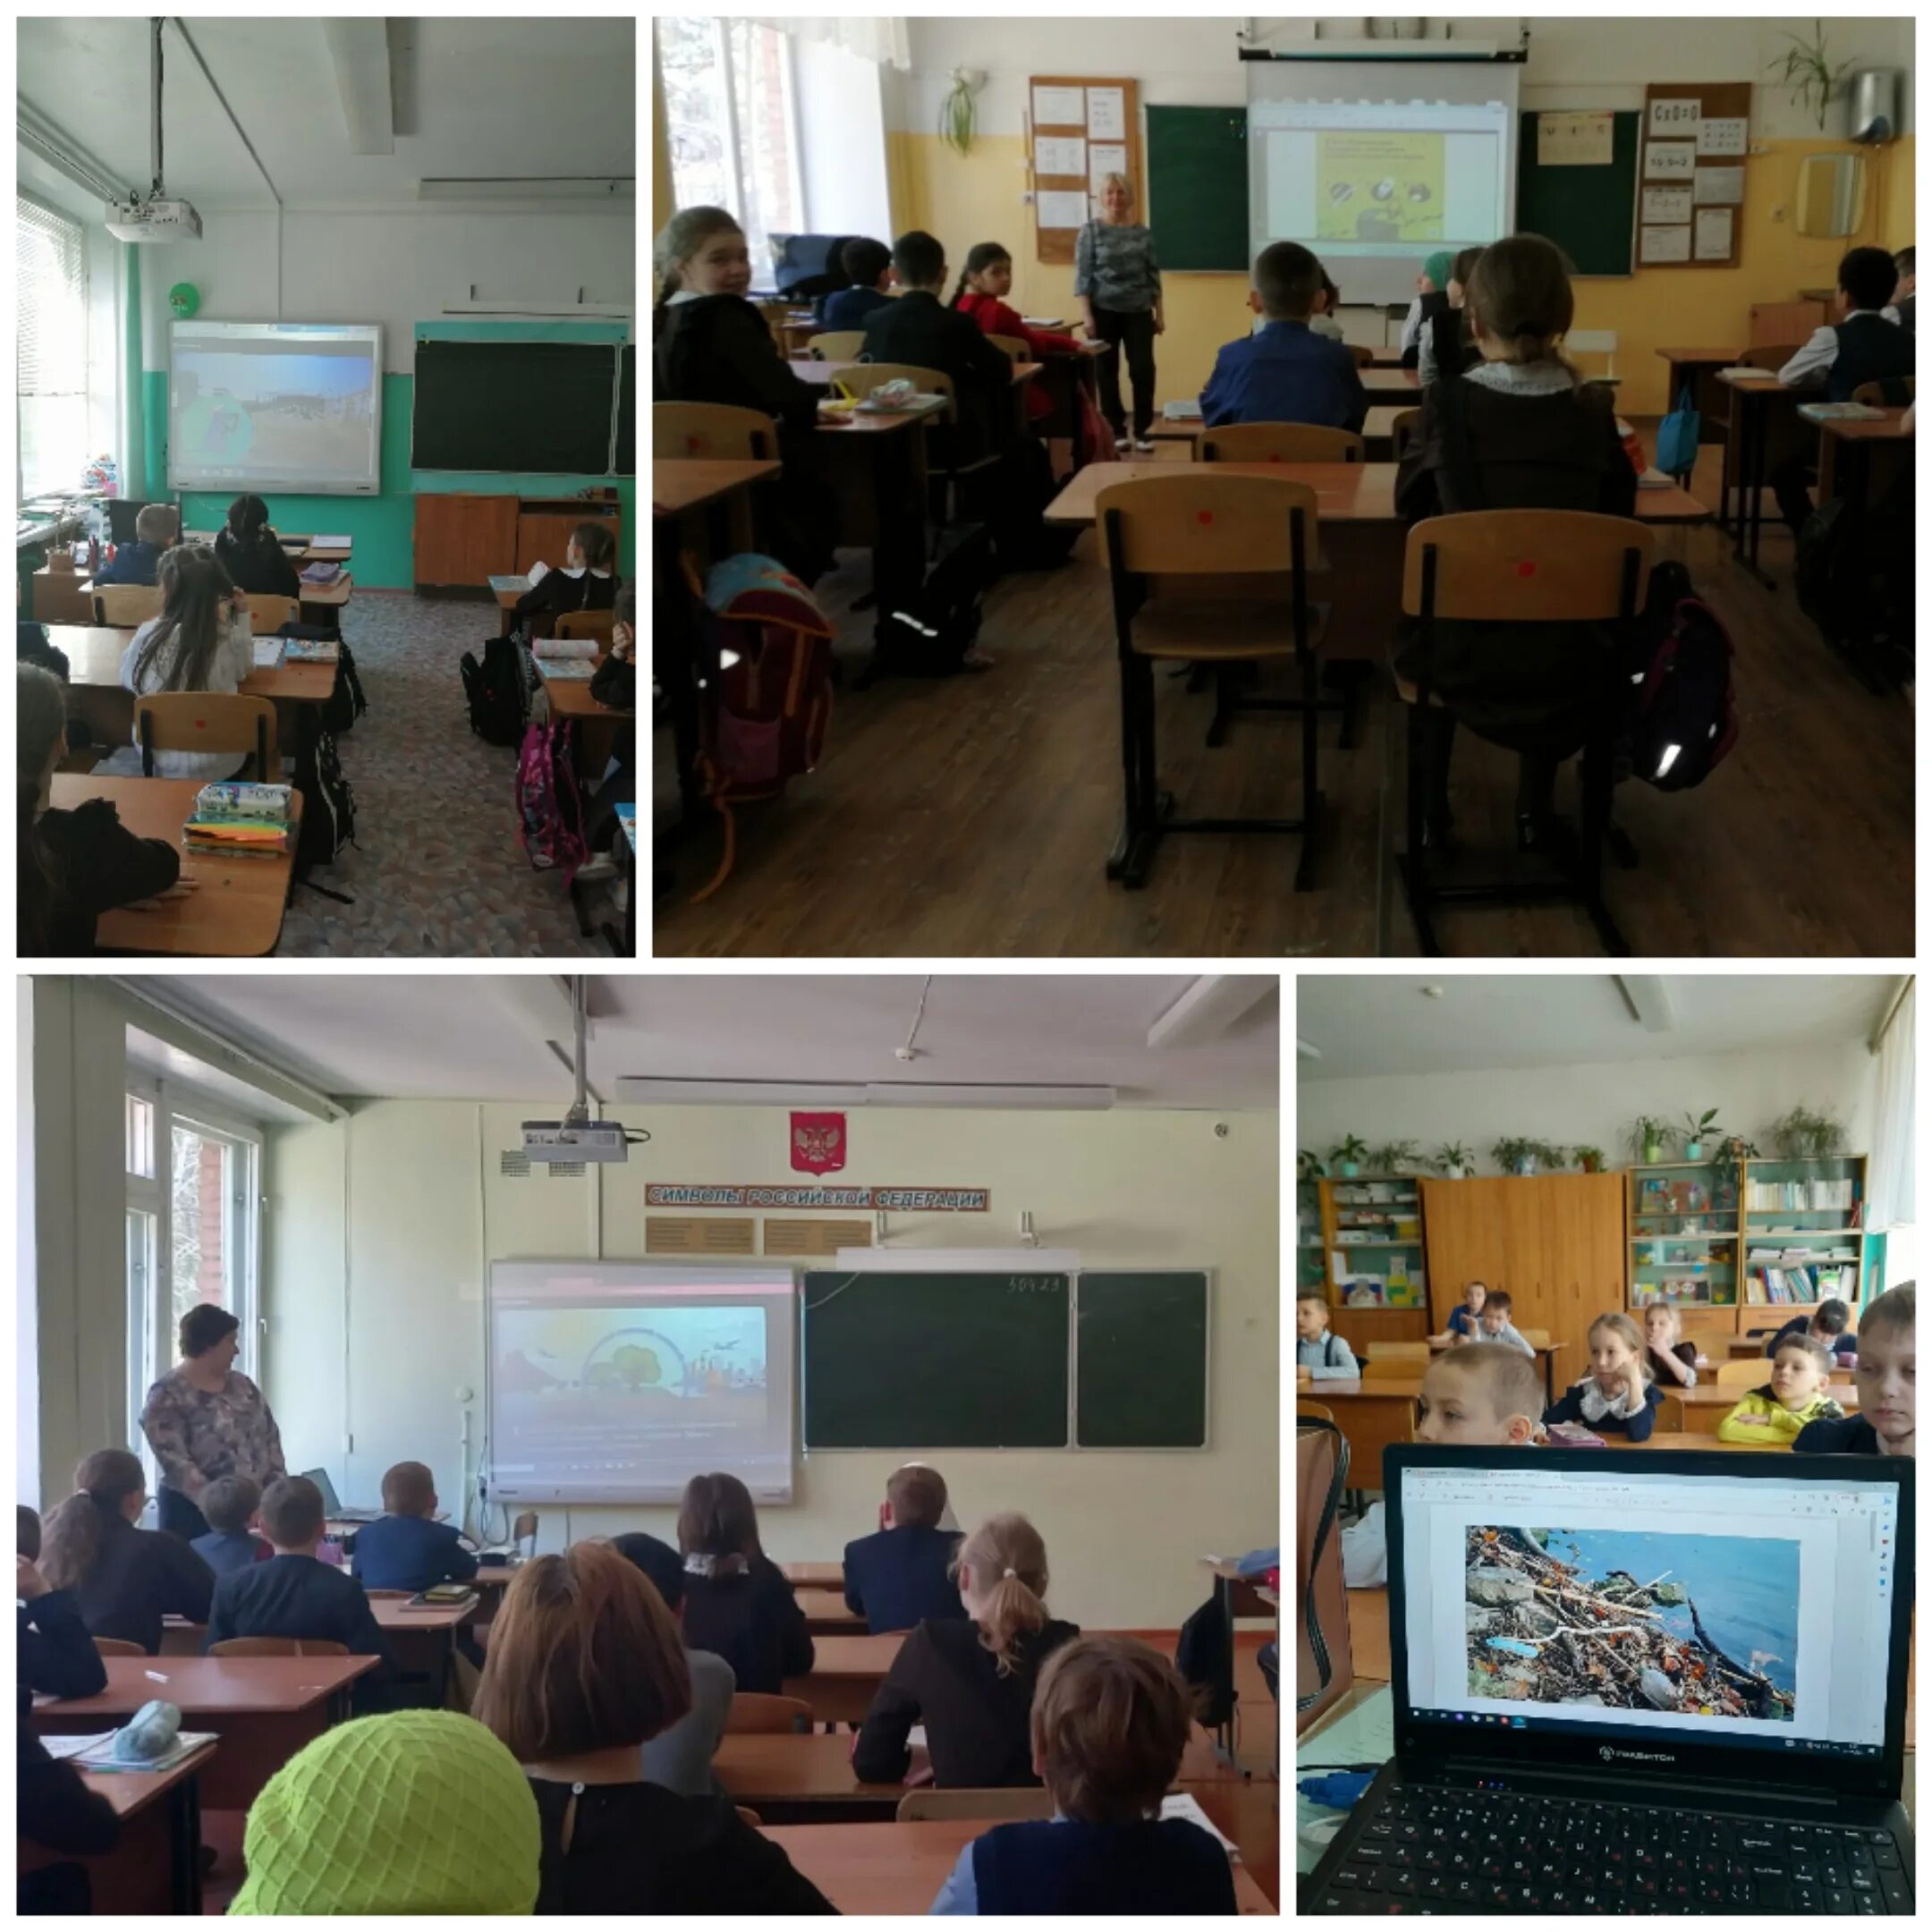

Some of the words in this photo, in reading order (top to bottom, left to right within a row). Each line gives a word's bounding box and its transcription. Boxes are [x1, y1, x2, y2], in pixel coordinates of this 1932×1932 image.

[650, 1186, 746, 1204] СИМВОЛЫ
[747, 1186, 871, 1207] РОССИЙСКОЙ
[876, 1191, 985, 1211] ФЕДЕРАЦИИ
